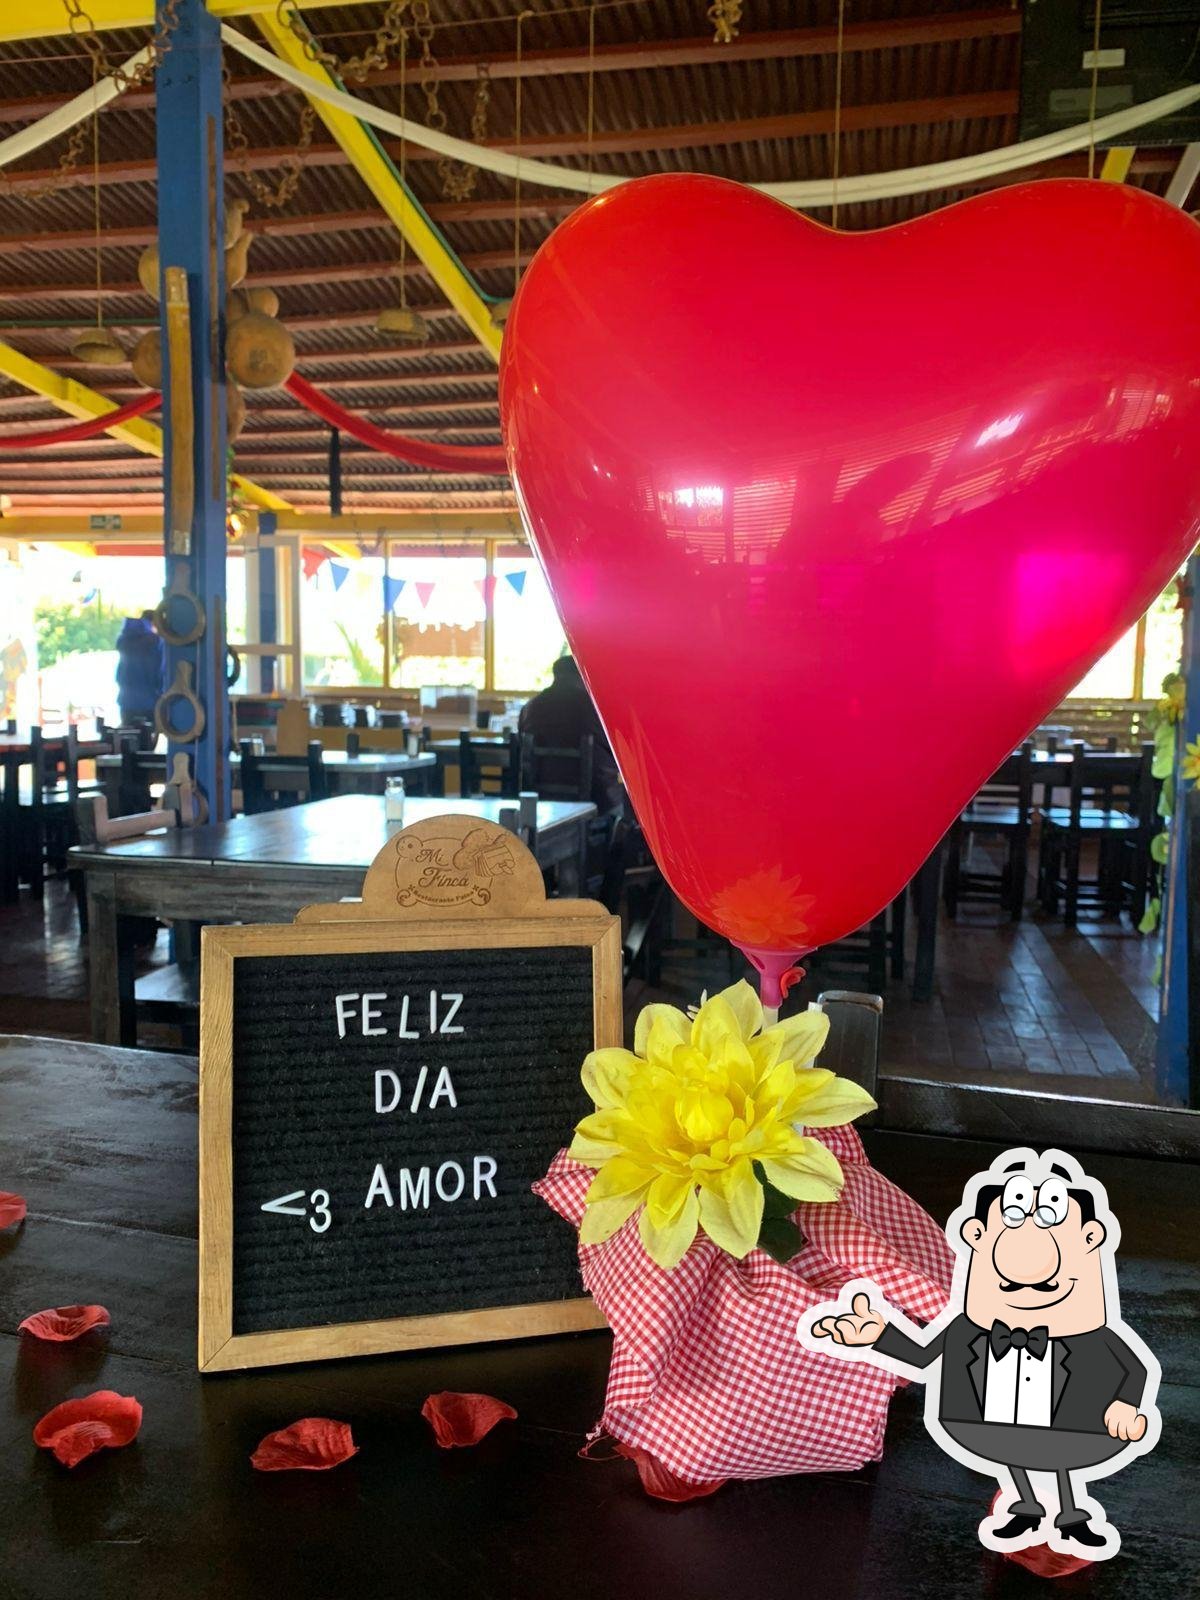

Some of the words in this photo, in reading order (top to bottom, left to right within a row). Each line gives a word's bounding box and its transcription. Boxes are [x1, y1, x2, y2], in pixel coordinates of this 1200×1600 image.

[415, 848, 449, 866] Mi
[335, 989, 465, 1039] FELIZ
[364, 1155, 498, 1211] AMOR
